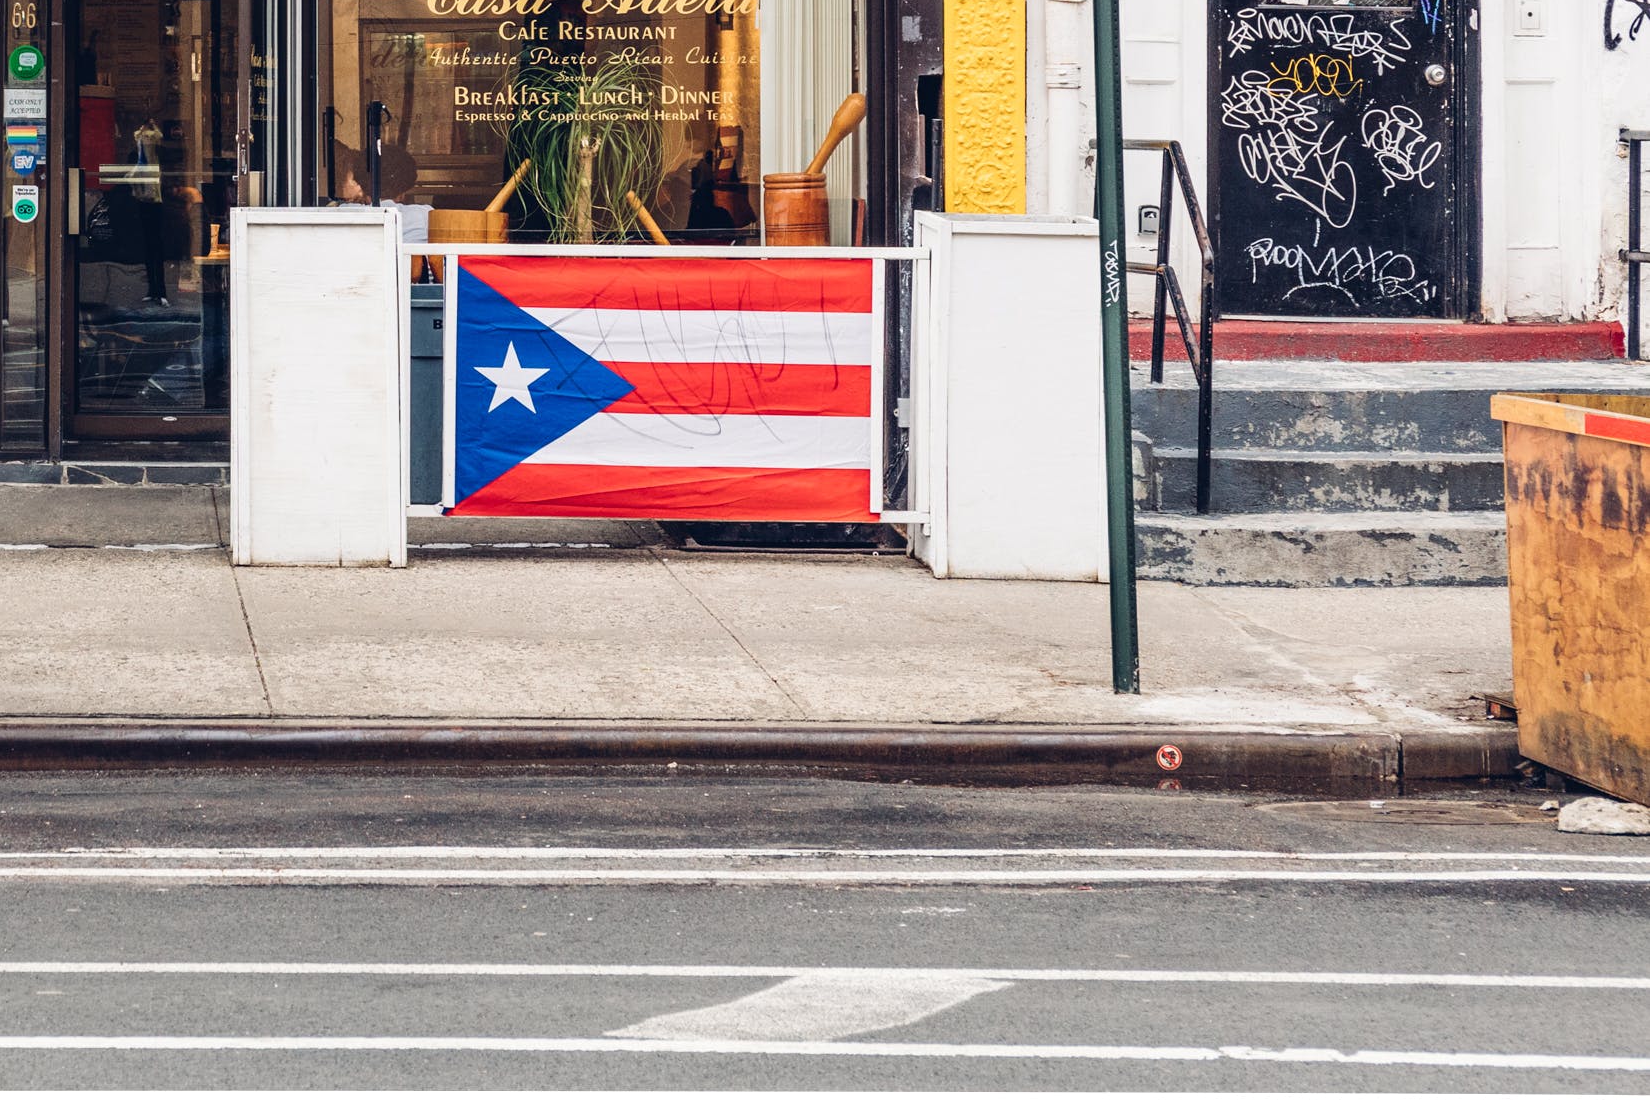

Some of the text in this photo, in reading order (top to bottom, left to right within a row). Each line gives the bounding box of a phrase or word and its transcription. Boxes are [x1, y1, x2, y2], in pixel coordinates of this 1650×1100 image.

[12, 2, 37, 29] 66
[430, 47, 518, 67] Authentic
[529, 46, 598, 65] Puerto
[608, 46, 675, 66] Rican
[521, 110, 532, 121] &
